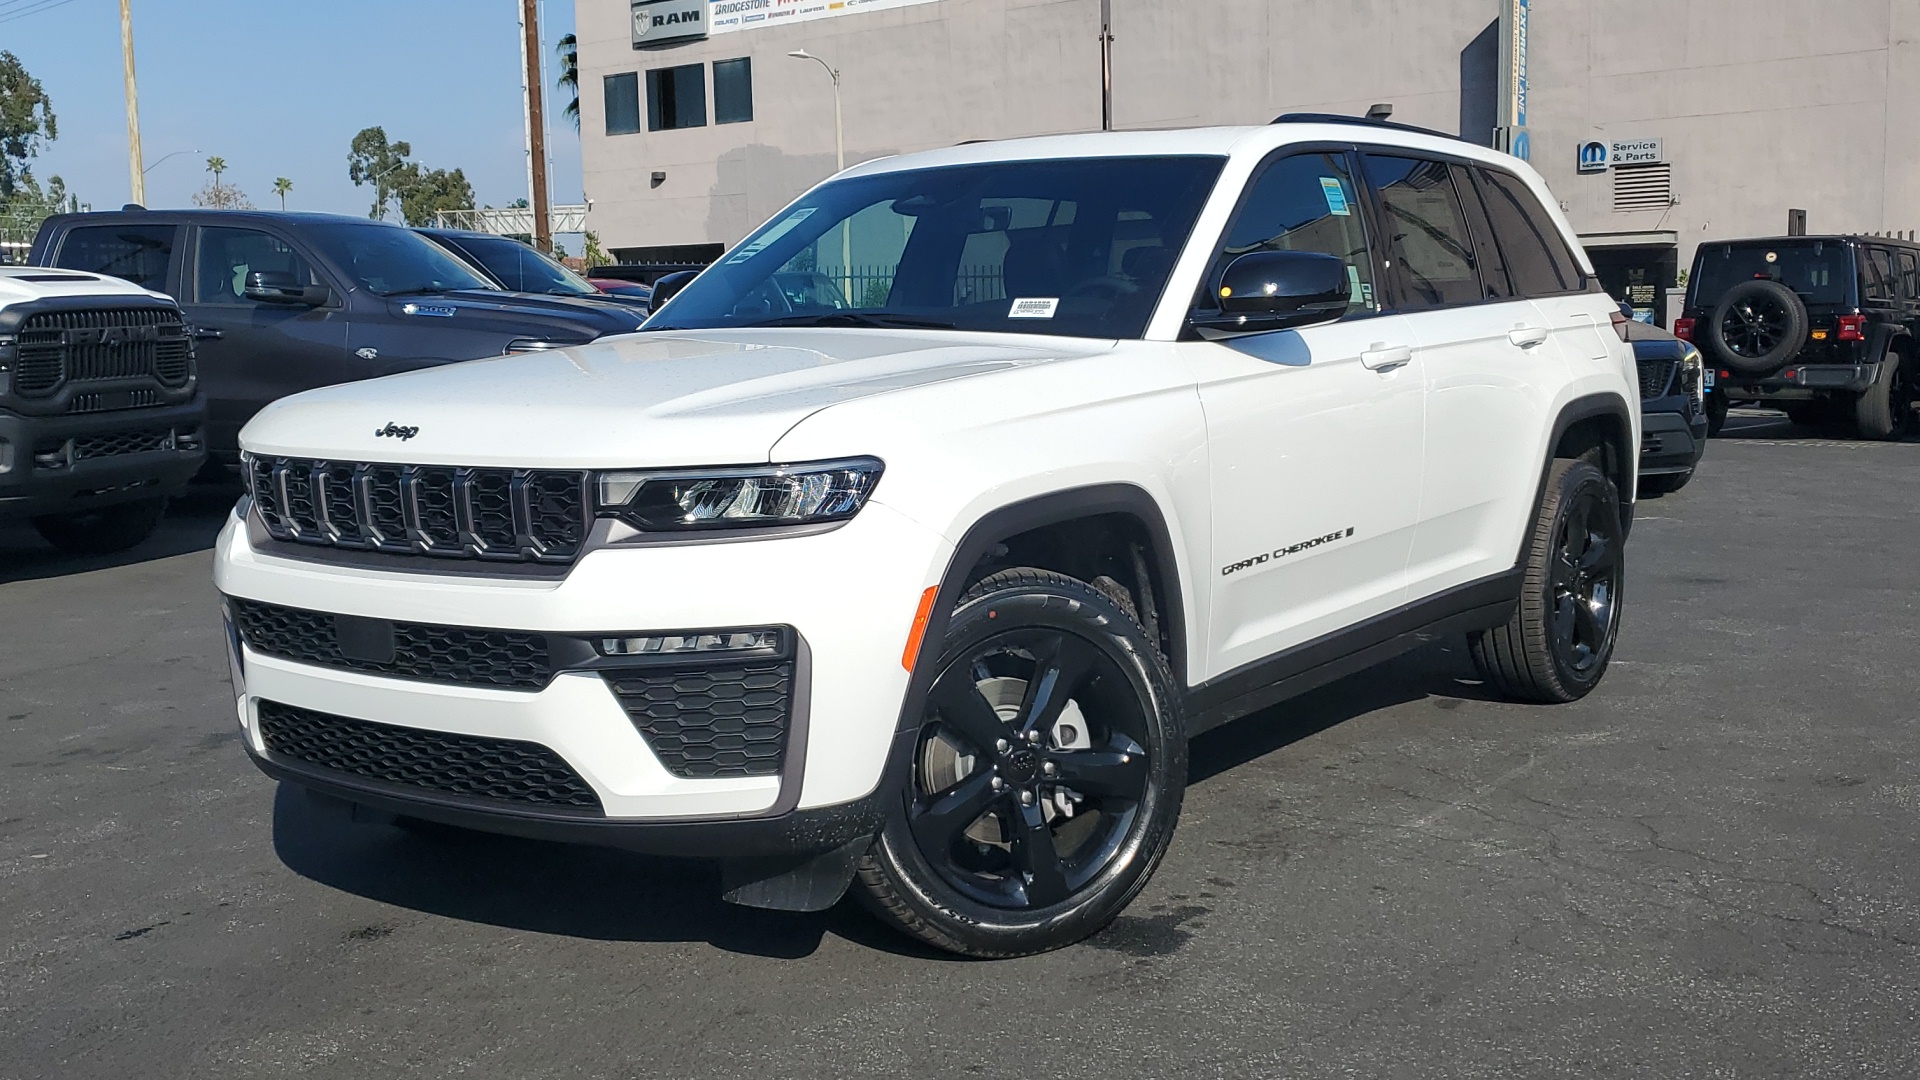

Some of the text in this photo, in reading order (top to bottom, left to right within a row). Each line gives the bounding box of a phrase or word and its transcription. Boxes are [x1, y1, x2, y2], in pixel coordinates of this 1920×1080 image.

[714, 0, 770, 15] BRIDGESTONE
[652, 10, 700, 27] RAM
[1612, 142, 1657, 151] Service
[1612, 152, 1656, 161] & Parts
[375, 421, 419, 441] Jeep
[1222, 530, 1343, 576] GRAND CHEROKEE
